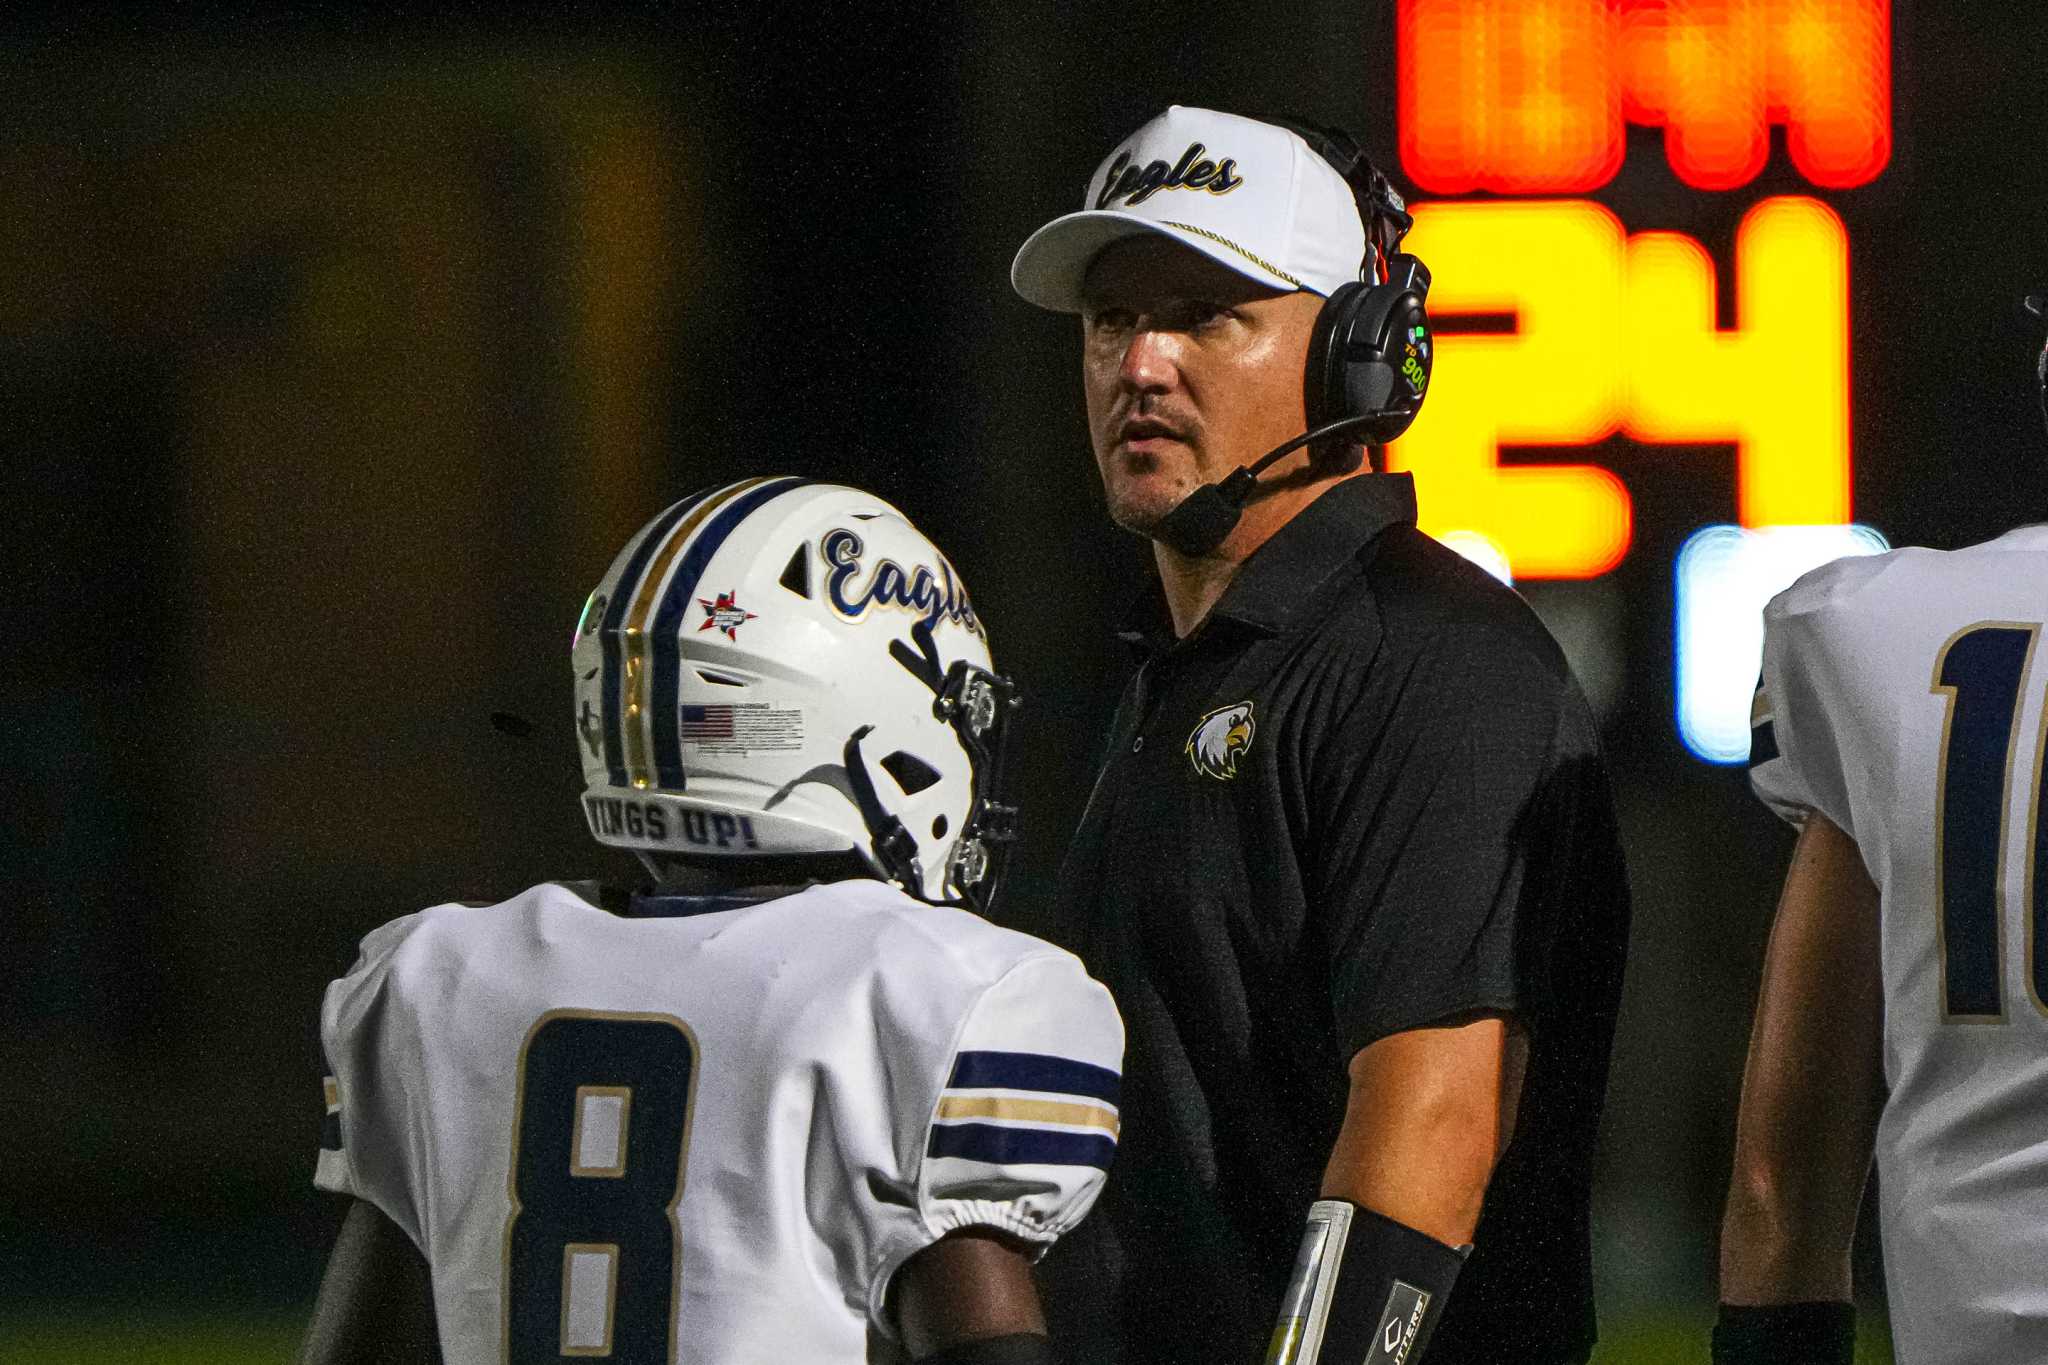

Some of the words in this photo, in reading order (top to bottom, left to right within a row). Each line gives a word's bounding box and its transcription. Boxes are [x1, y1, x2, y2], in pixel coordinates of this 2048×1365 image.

[1385, 196, 1853, 579] 24
[680, 806, 758, 849] UP!
[1930, 622, 2048, 1030] 1
[501, 1008, 700, 1365] 8
